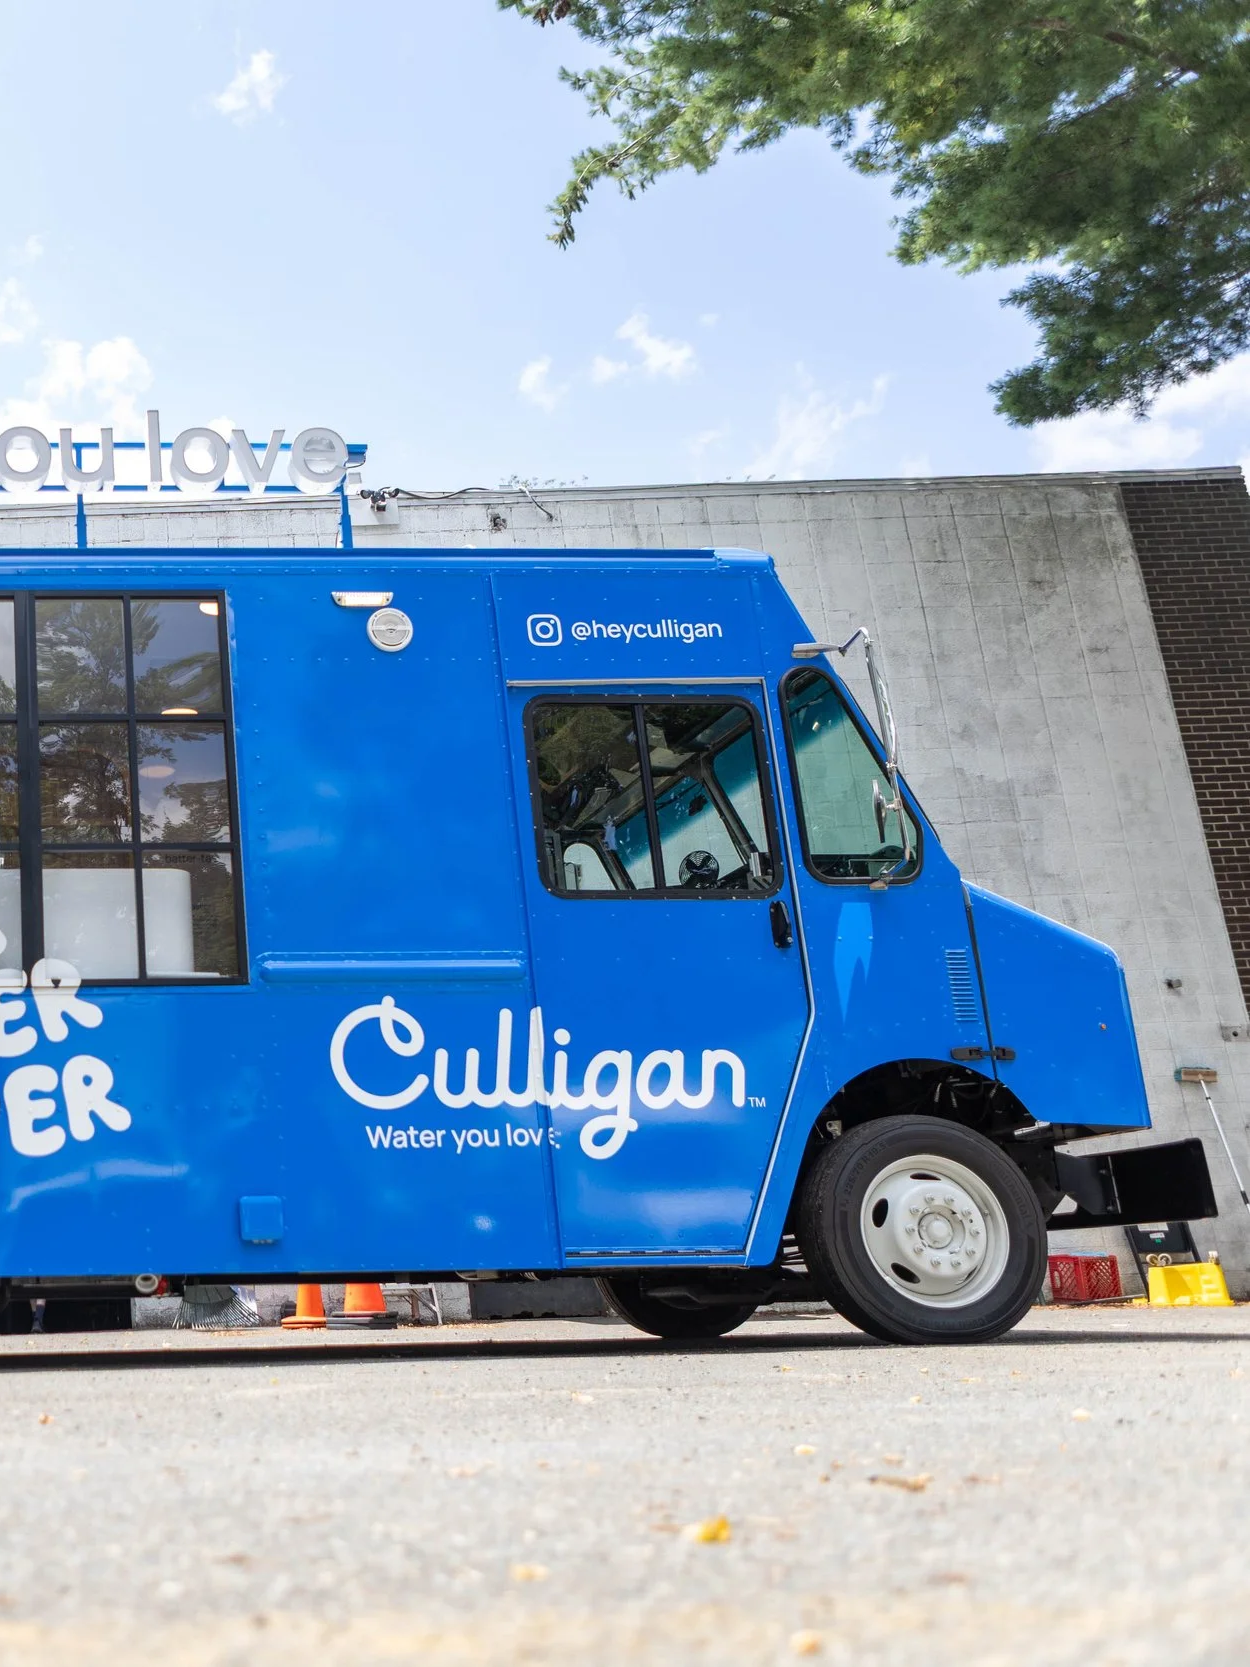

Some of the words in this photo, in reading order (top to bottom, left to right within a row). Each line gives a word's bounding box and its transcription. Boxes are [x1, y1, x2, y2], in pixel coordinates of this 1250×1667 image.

[147, 410, 363, 494] love.
[571, 619, 723, 644] @heyculligan
[329, 995, 746, 1160] Culligan
[365, 1125, 446, 1149] Water
[451, 1128, 500, 1155] you
